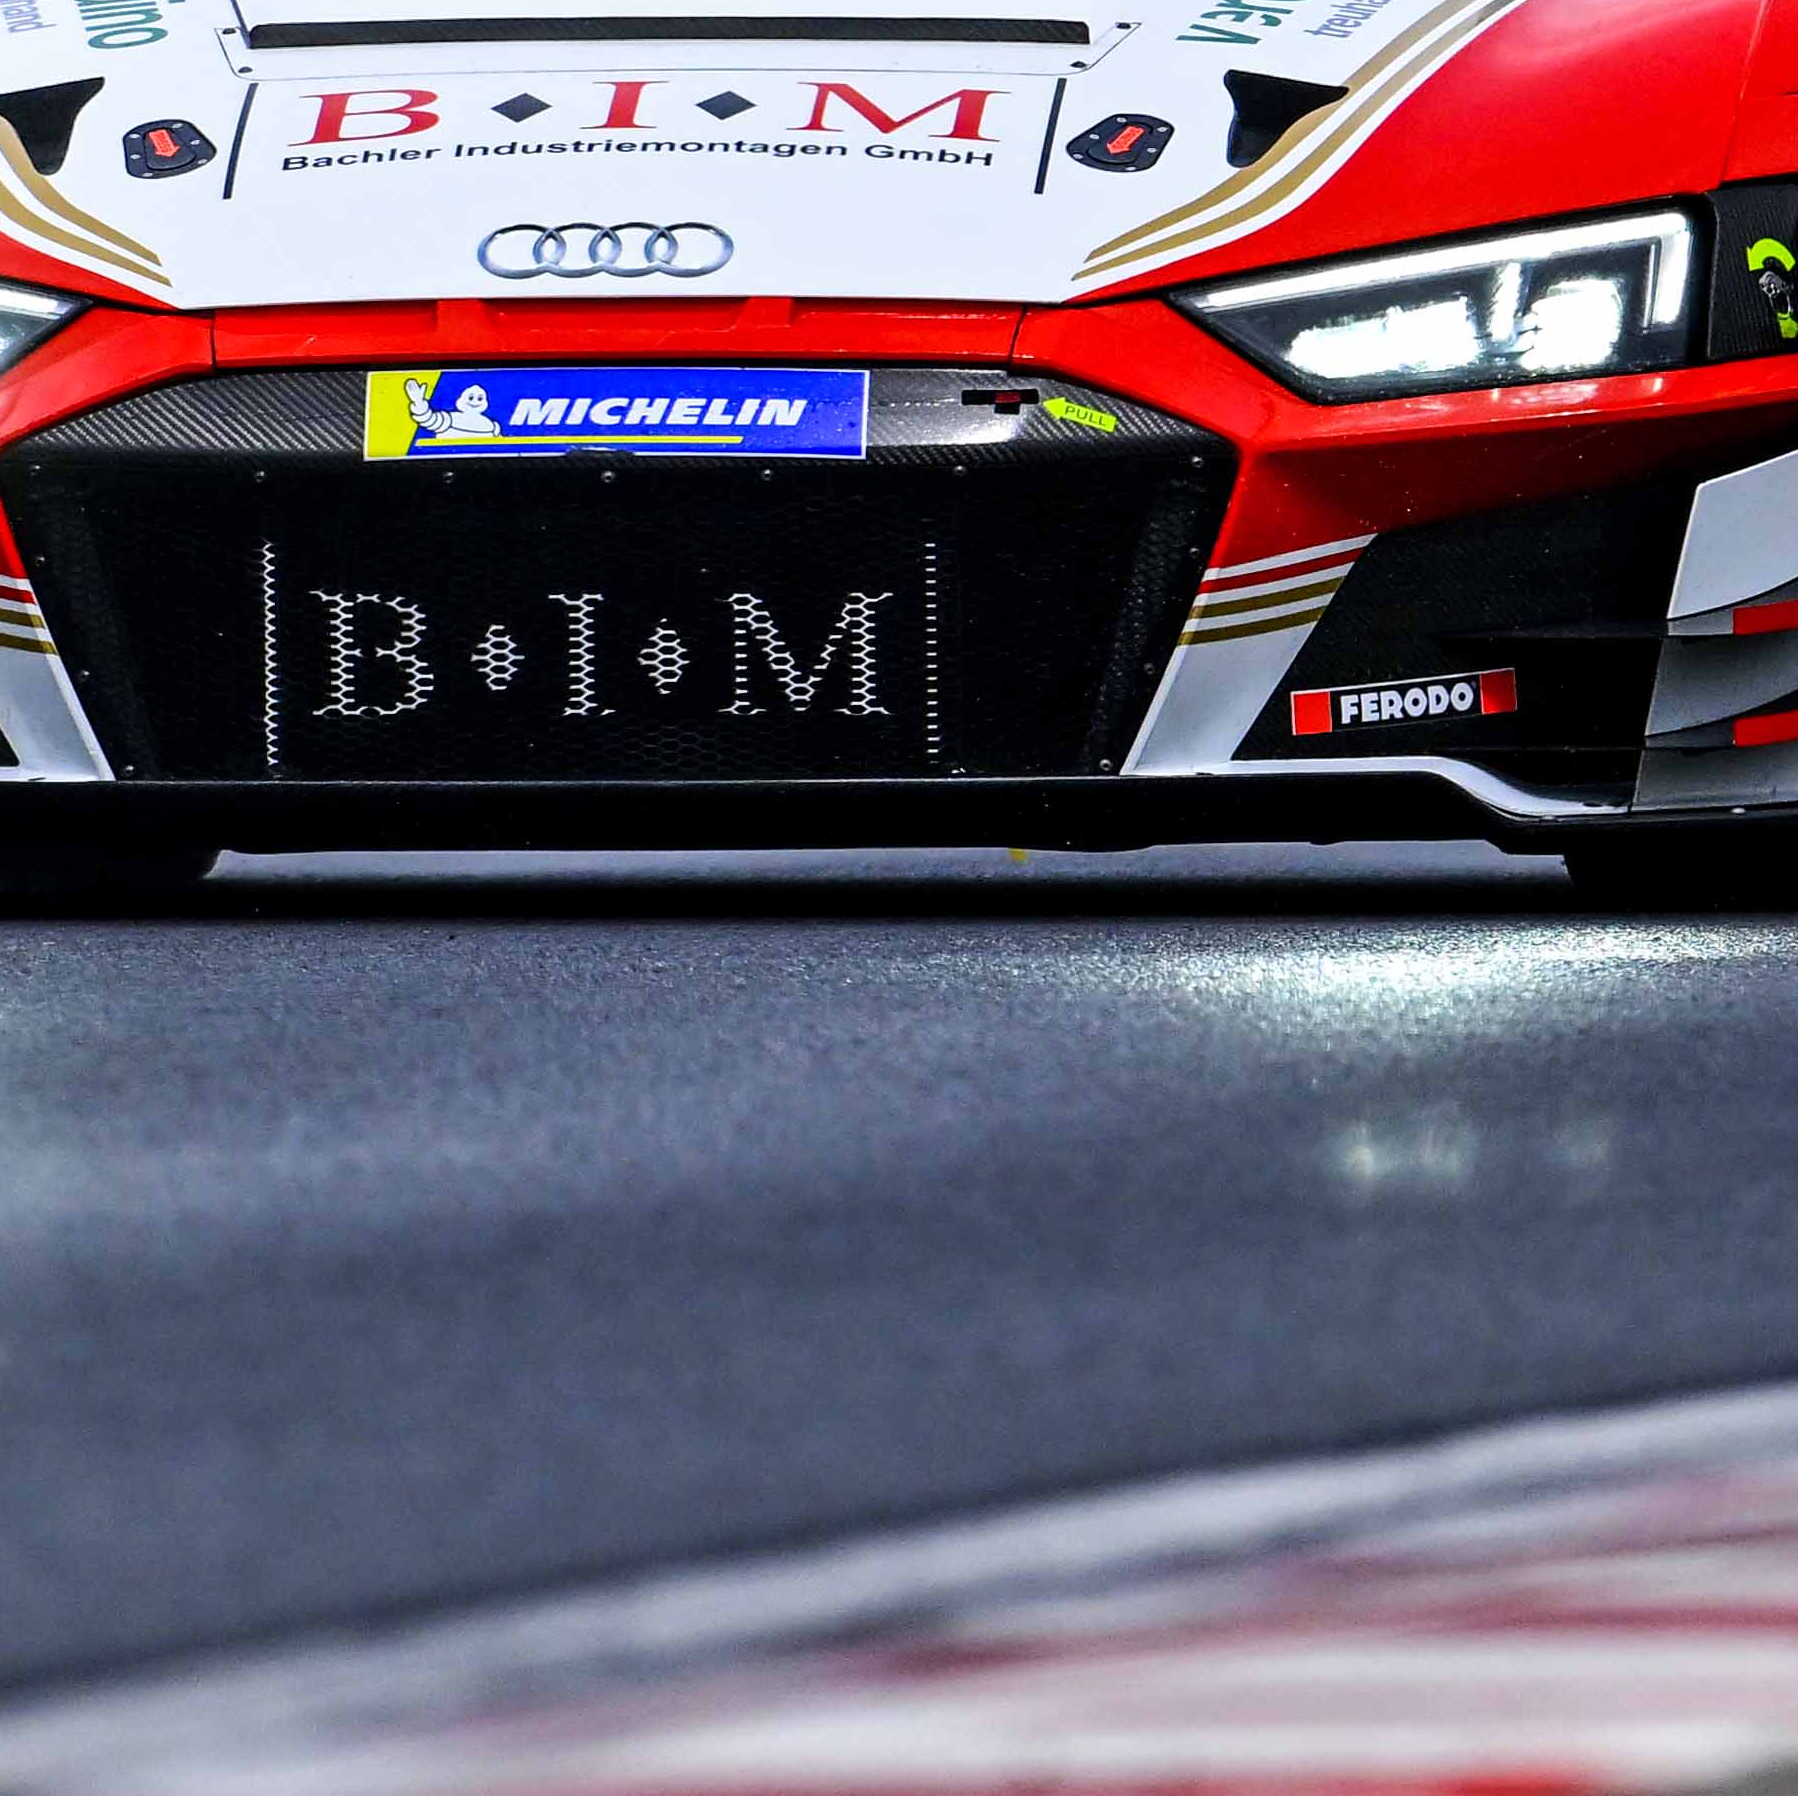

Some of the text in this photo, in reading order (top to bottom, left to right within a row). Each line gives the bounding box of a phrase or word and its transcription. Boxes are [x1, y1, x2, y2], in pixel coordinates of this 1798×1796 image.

[281, 139, 993, 172] Bachler Industriemontagen GmbH
[509, 397, 808, 427] MICHELIN
[1065, 405, 1107, 427] PULL
[1341, 682, 1473, 724] FERODO
